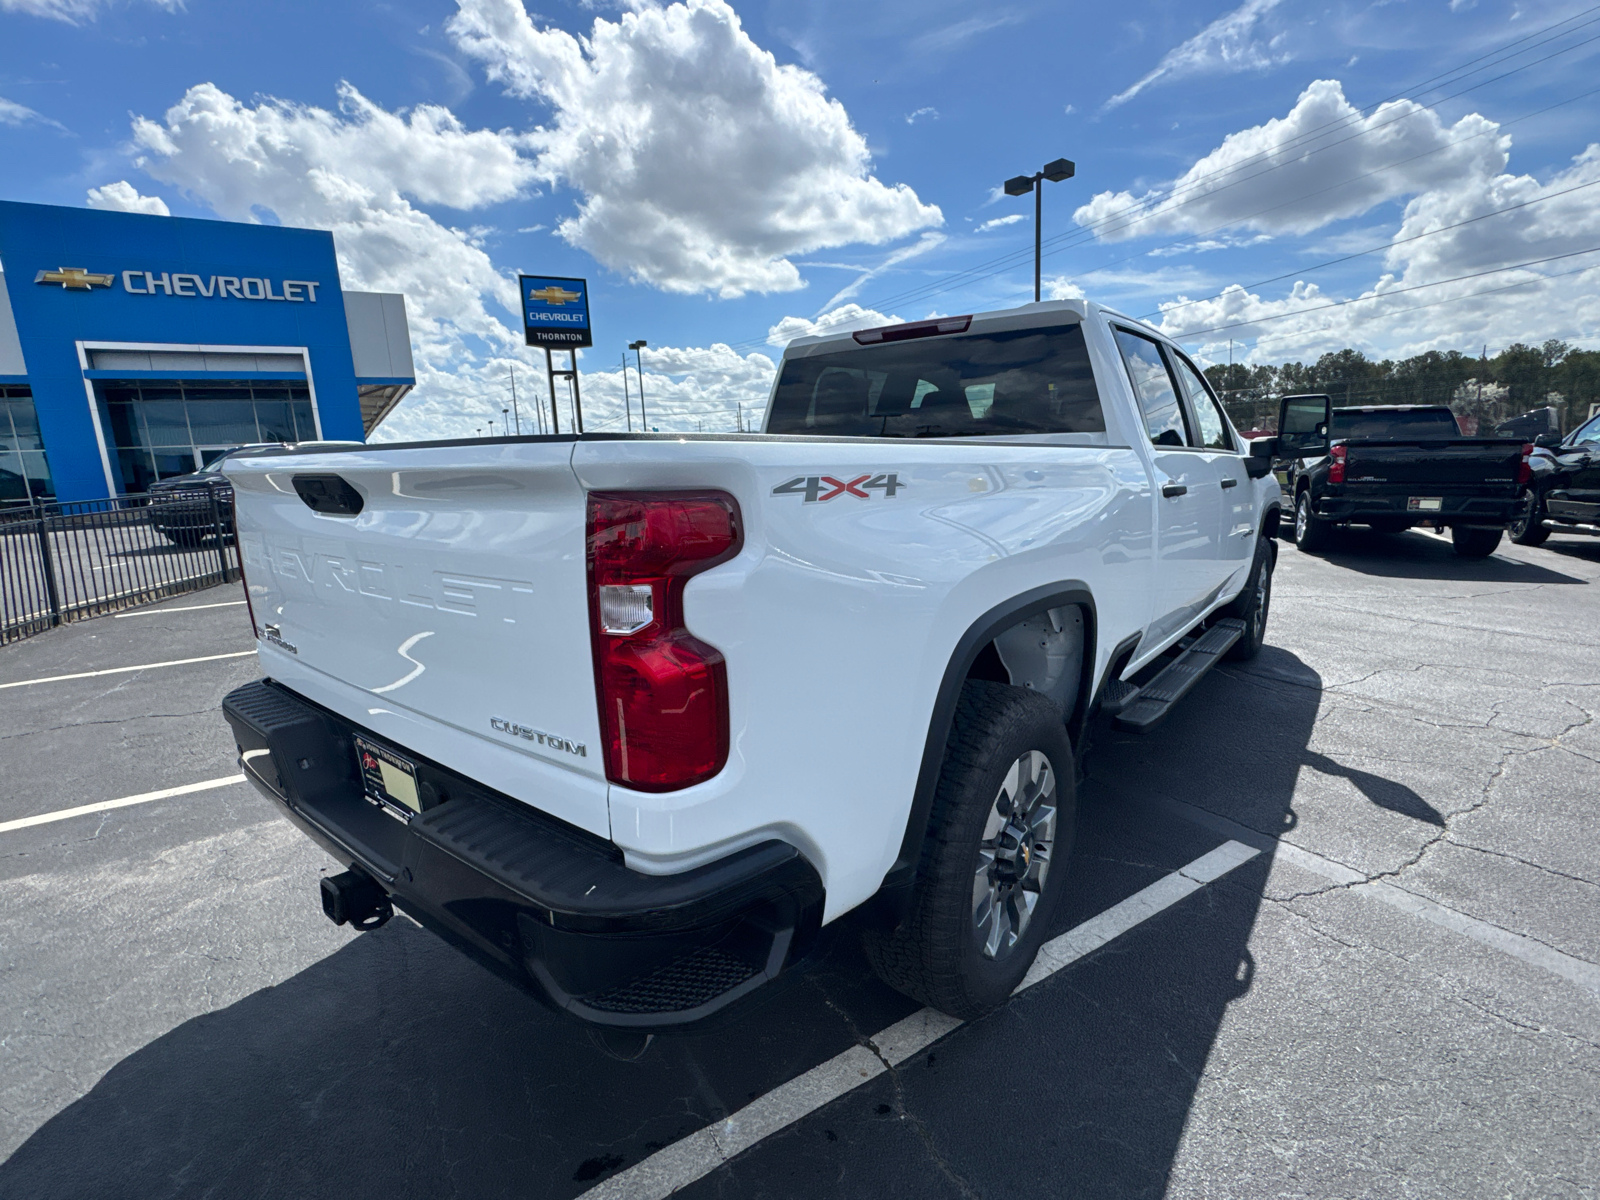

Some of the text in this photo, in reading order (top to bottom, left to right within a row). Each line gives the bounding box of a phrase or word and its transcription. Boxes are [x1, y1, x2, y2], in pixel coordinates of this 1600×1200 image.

[122, 270, 320, 302] CHEVROLET
[529, 312, 584, 322] CHEVROLET
[536, 332, 583, 341] THORNTON
[771, 473, 906, 504] 4X4
[490, 716, 588, 757] CUSTOM
